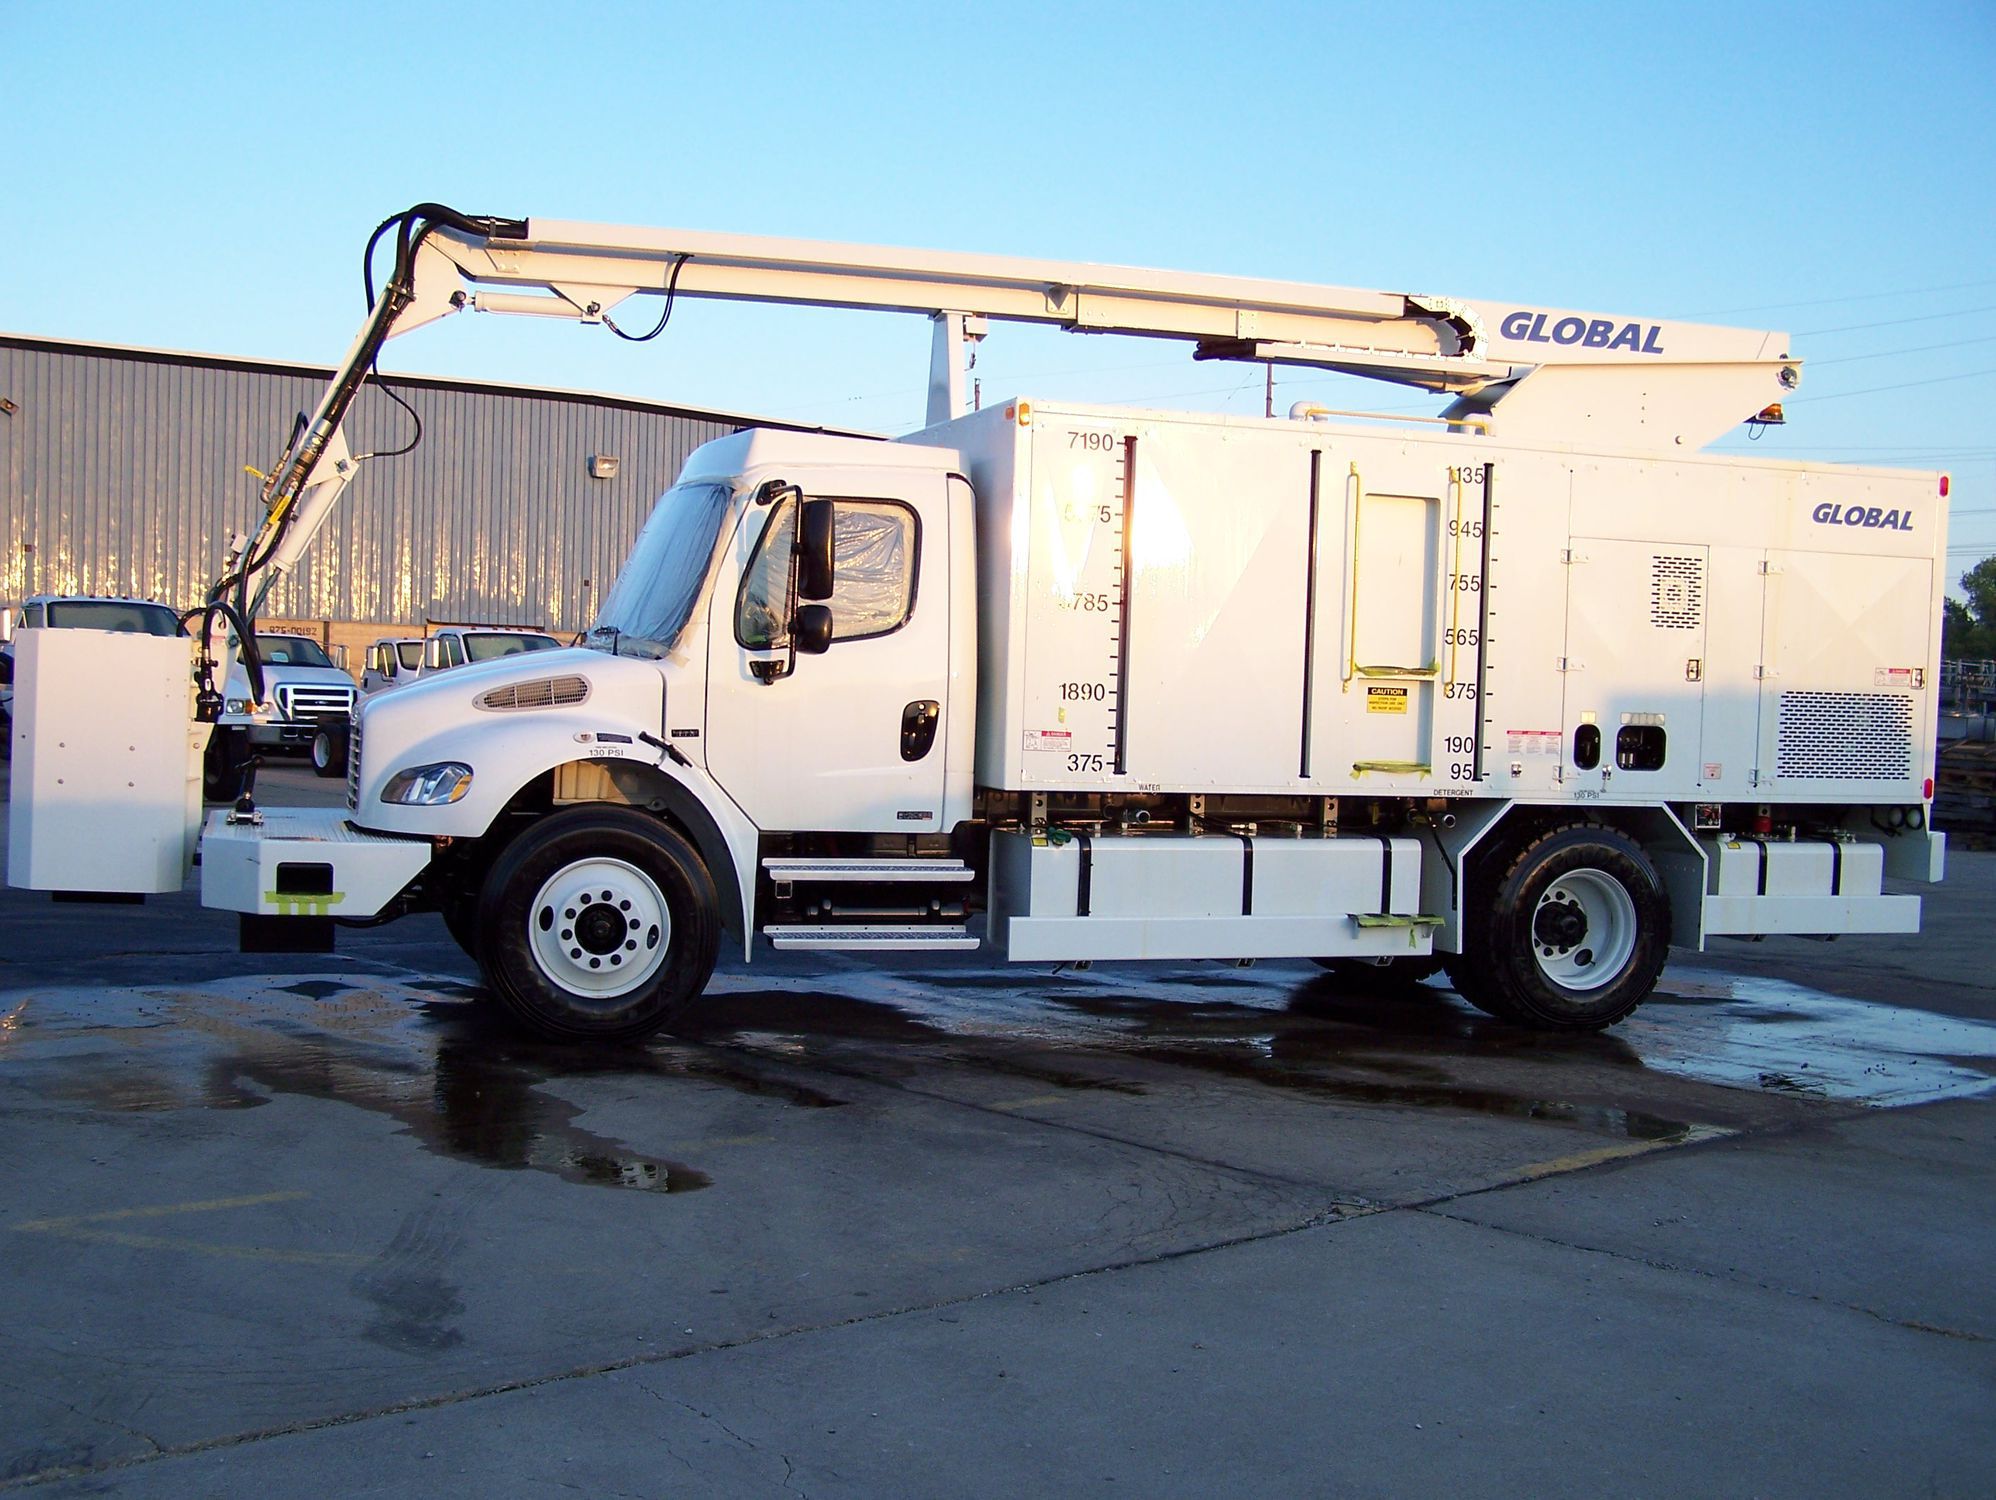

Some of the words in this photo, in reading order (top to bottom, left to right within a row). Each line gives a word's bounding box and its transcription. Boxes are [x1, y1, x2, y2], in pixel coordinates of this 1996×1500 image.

[1500, 311, 1665, 355] GLOBAL
[1067, 431, 1114, 452] 7190
[1811, 502, 1915, 532] GLOBAL
[1449, 519, 1483, 538] 945
[1448, 573, 1480, 592] 755
[1058, 592, 1108, 612] 785
[1444, 628, 1479, 646] 565
[1058, 682, 1105, 701] 1890
[1445, 682, 1476, 700] 375
[589, 749, 604, 757] 130
[607, 749, 624, 757] PSI
[1444, 736, 1474, 753] 190
[1067, 753, 1103, 772] 375
[1450, 763, 1473, 780] 95
[1138, 784, 1161, 792] WATER
